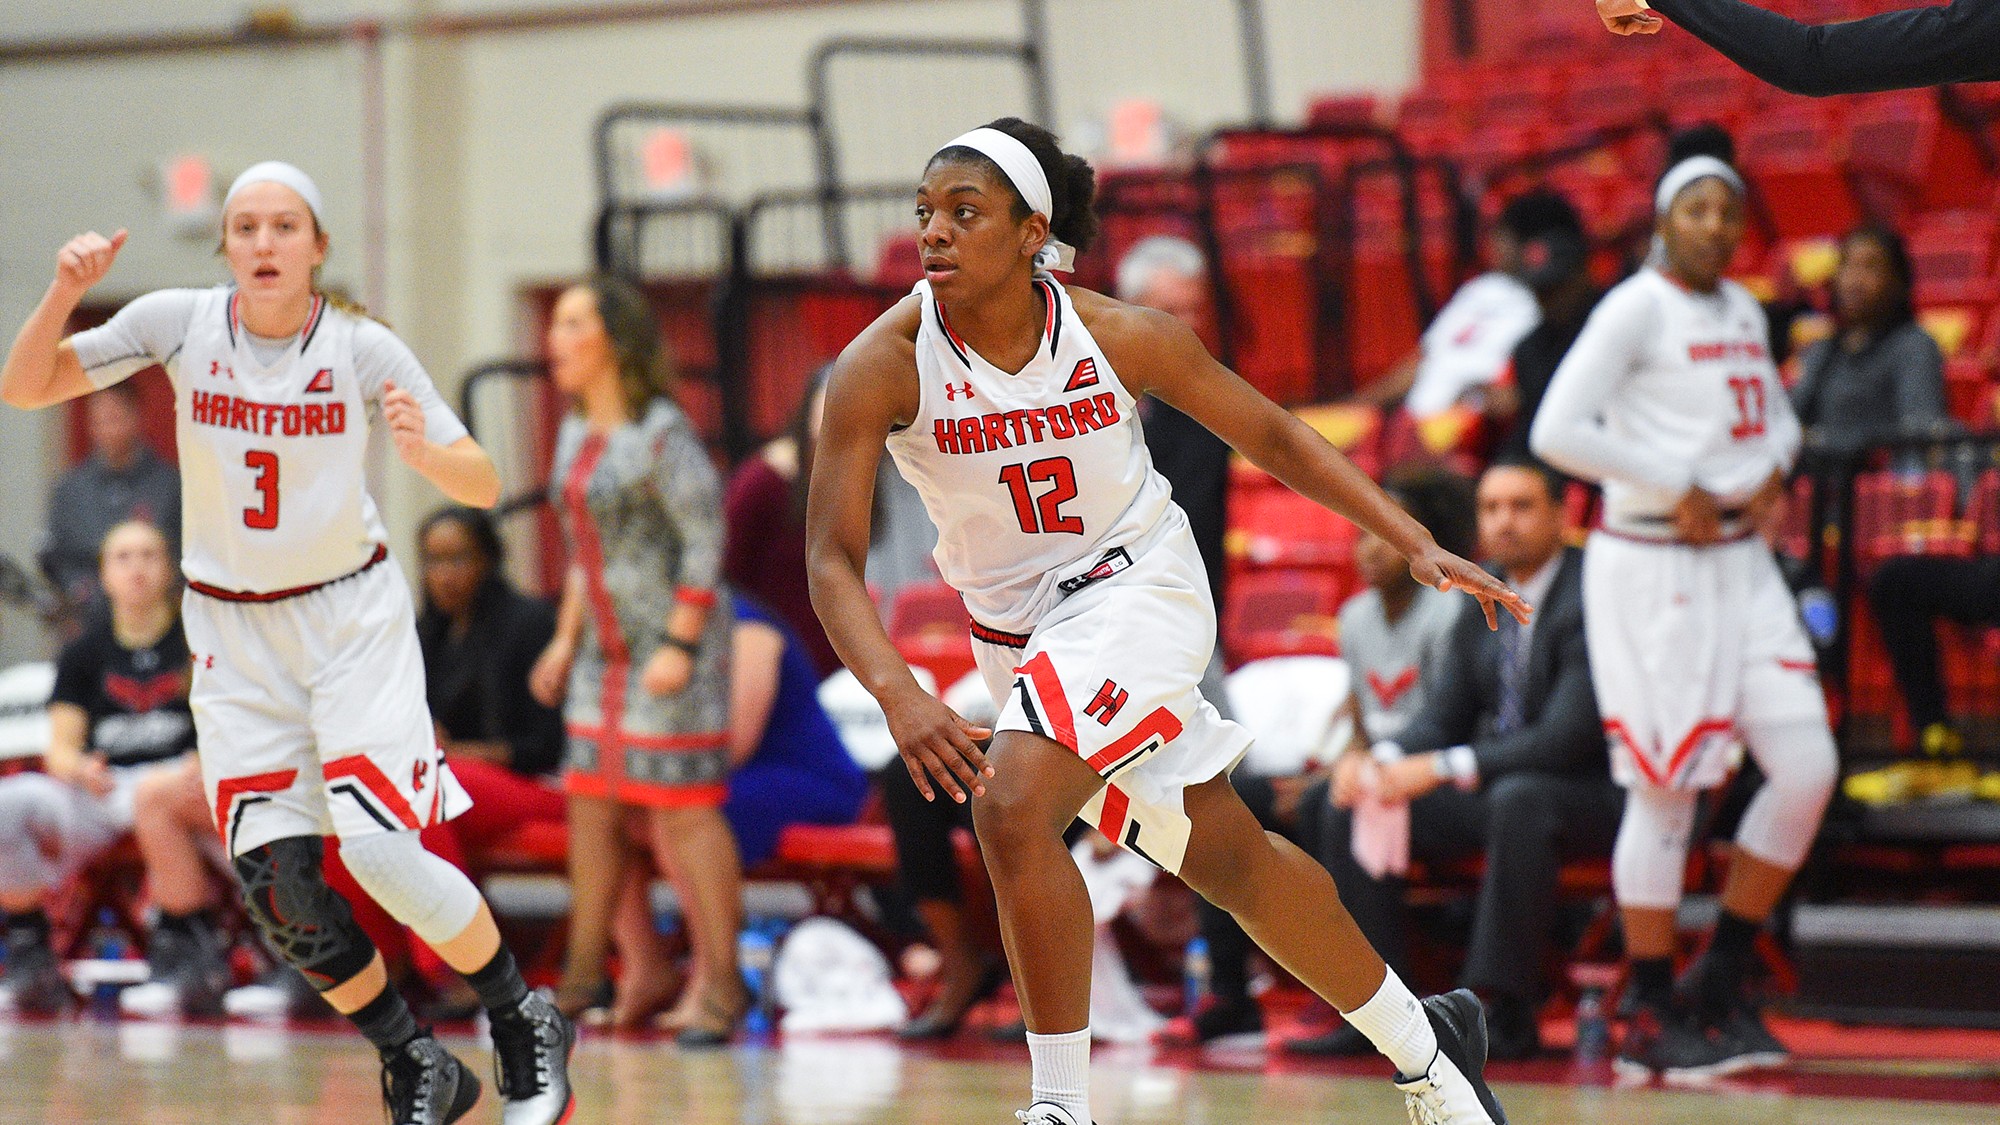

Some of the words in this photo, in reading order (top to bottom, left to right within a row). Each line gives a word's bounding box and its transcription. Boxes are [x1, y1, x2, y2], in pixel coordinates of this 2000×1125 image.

[192, 389, 347, 437] HARTFORD
[932, 391, 1121, 455] HARTFORD
[243, 449, 280, 531] 3
[998, 455, 1085, 536] 12
